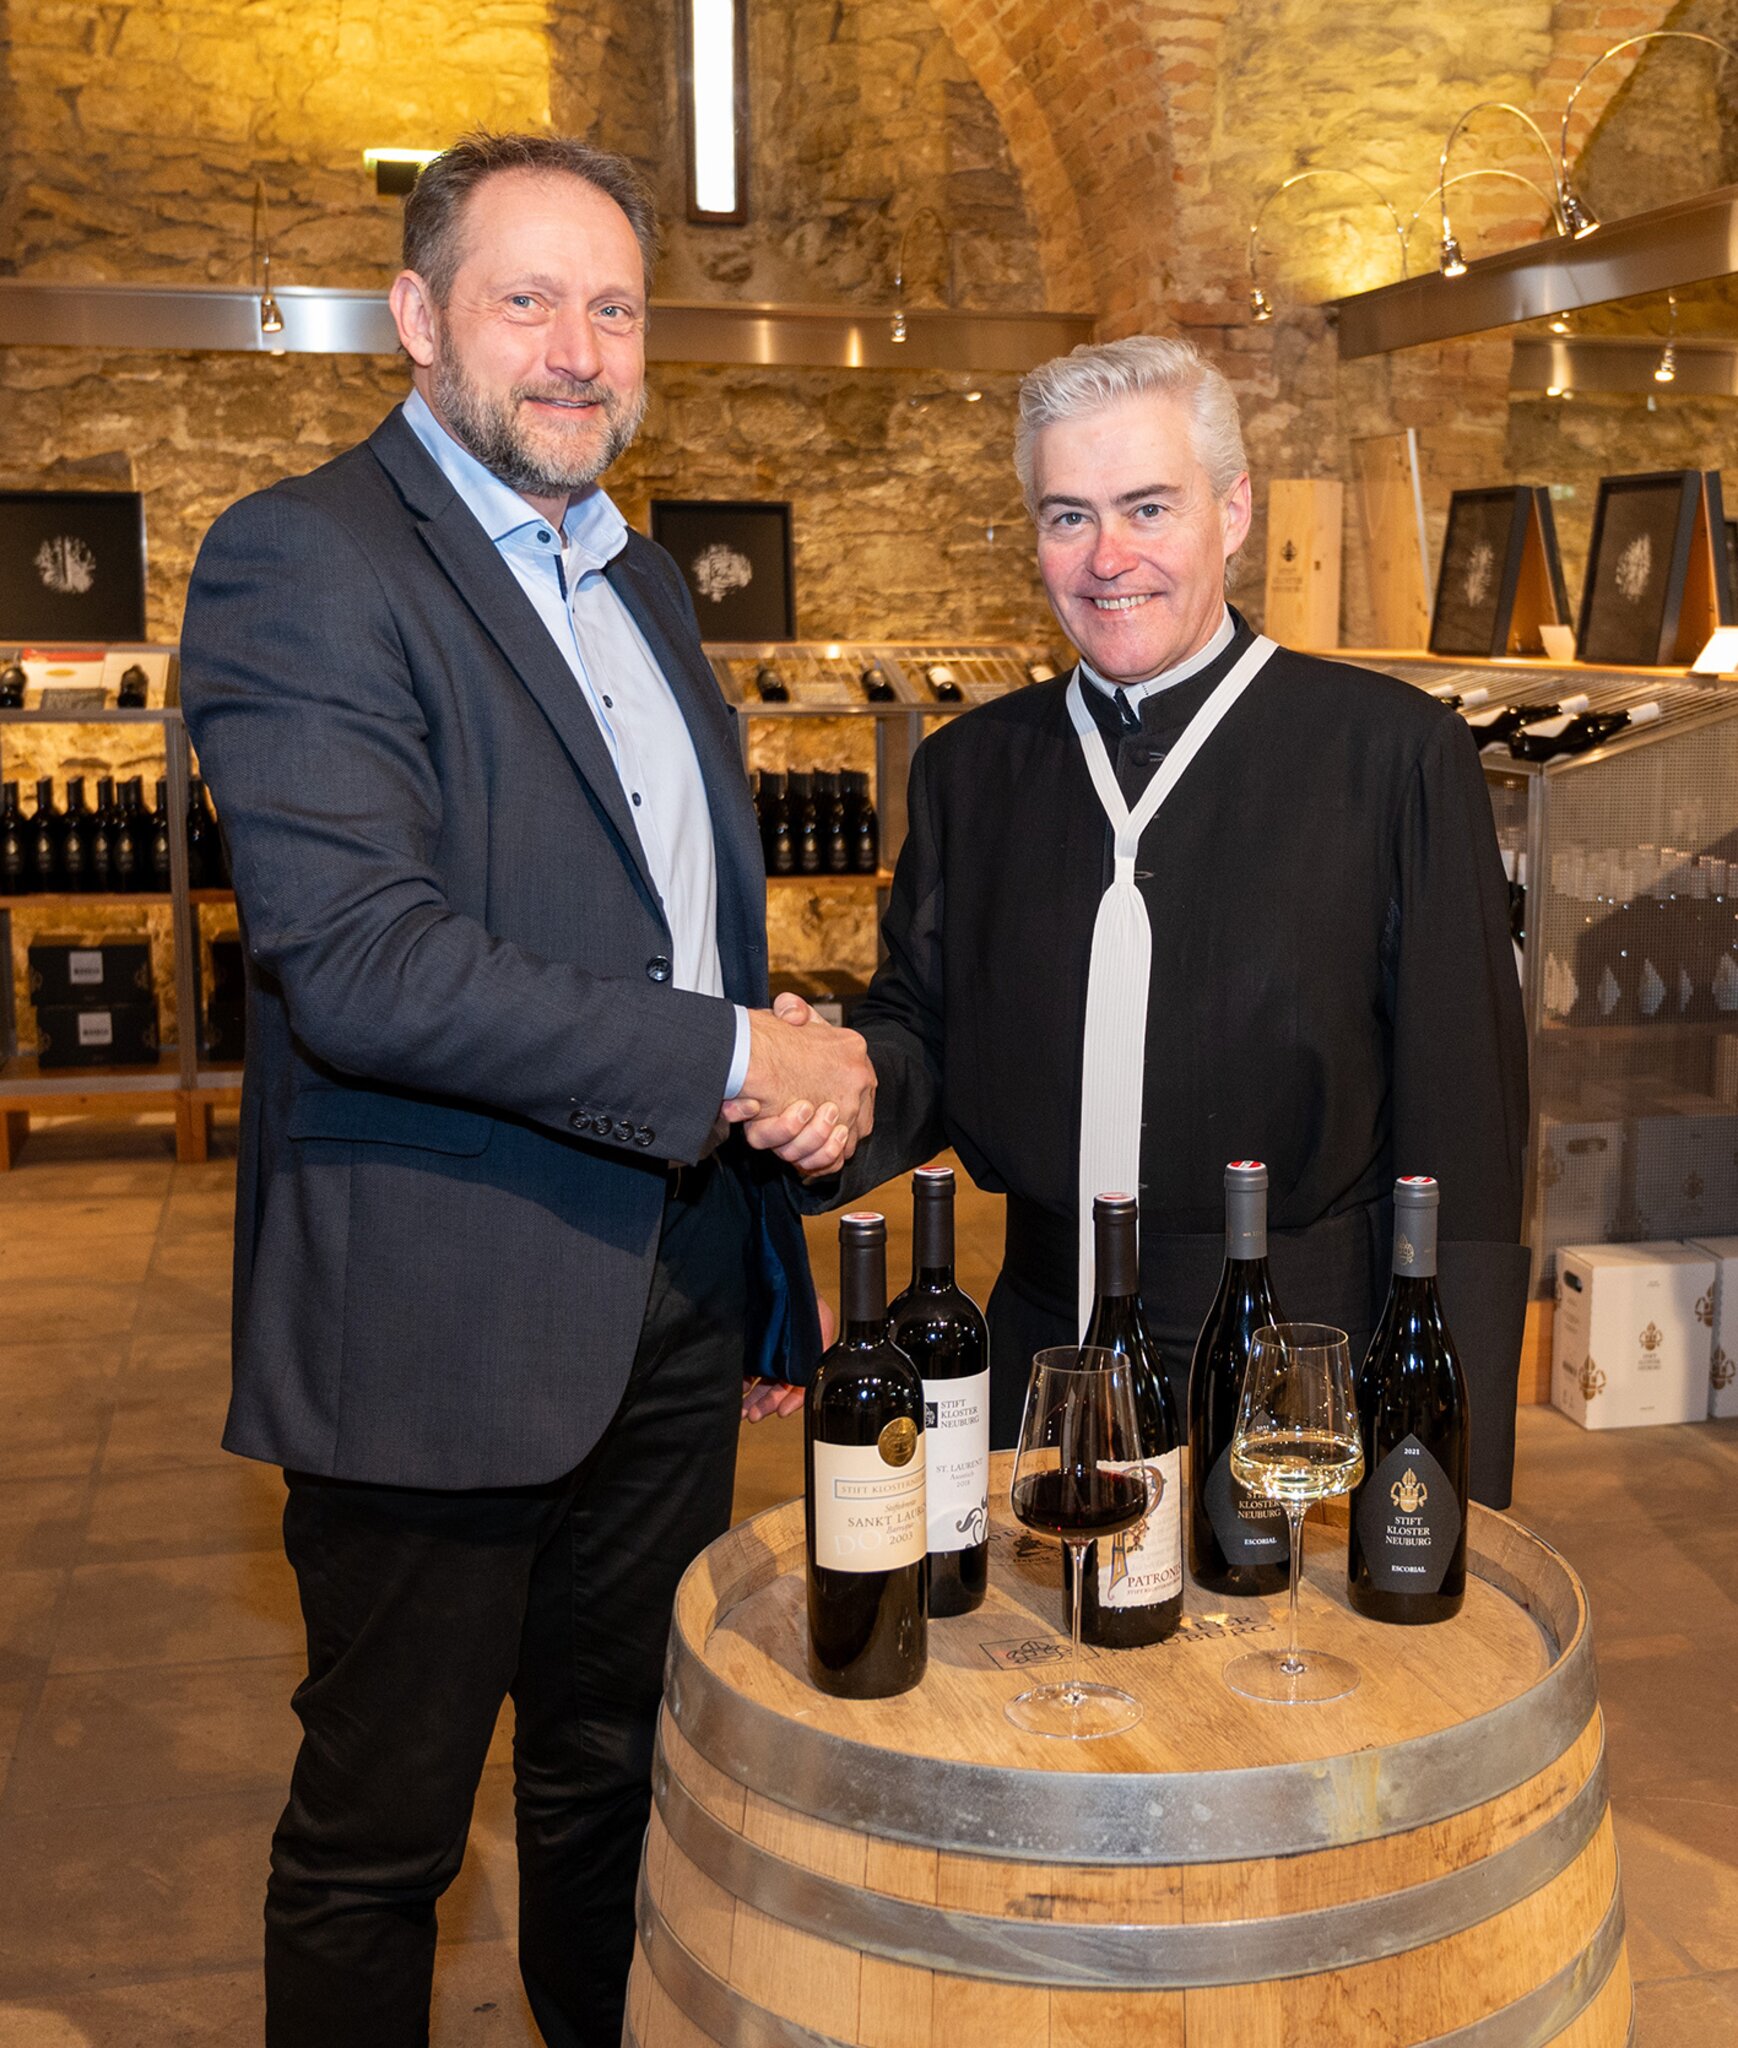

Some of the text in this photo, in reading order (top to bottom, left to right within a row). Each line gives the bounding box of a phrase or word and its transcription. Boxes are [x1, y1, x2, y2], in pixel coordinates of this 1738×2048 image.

[941, 1399, 966, 1409] STIFT
[941, 1407, 977, 1418] KLOSTER
[941, 1415, 980, 1428] NEUBURG
[1403, 1447, 1420, 1455] 2021
[1238, 1509, 1281, 1519] NEUBURG
[848, 1515, 892, 1527] SANKT
[1395, 1516, 1423, 1526] STIFT
[1386, 1525, 1431, 1536] KLOSTER
[1244, 1537, 1277, 1545] ESCORIAL
[1385, 1535, 1432, 1546] NEUBURG
[1391, 1565, 1426, 1573] ESCORIAL
